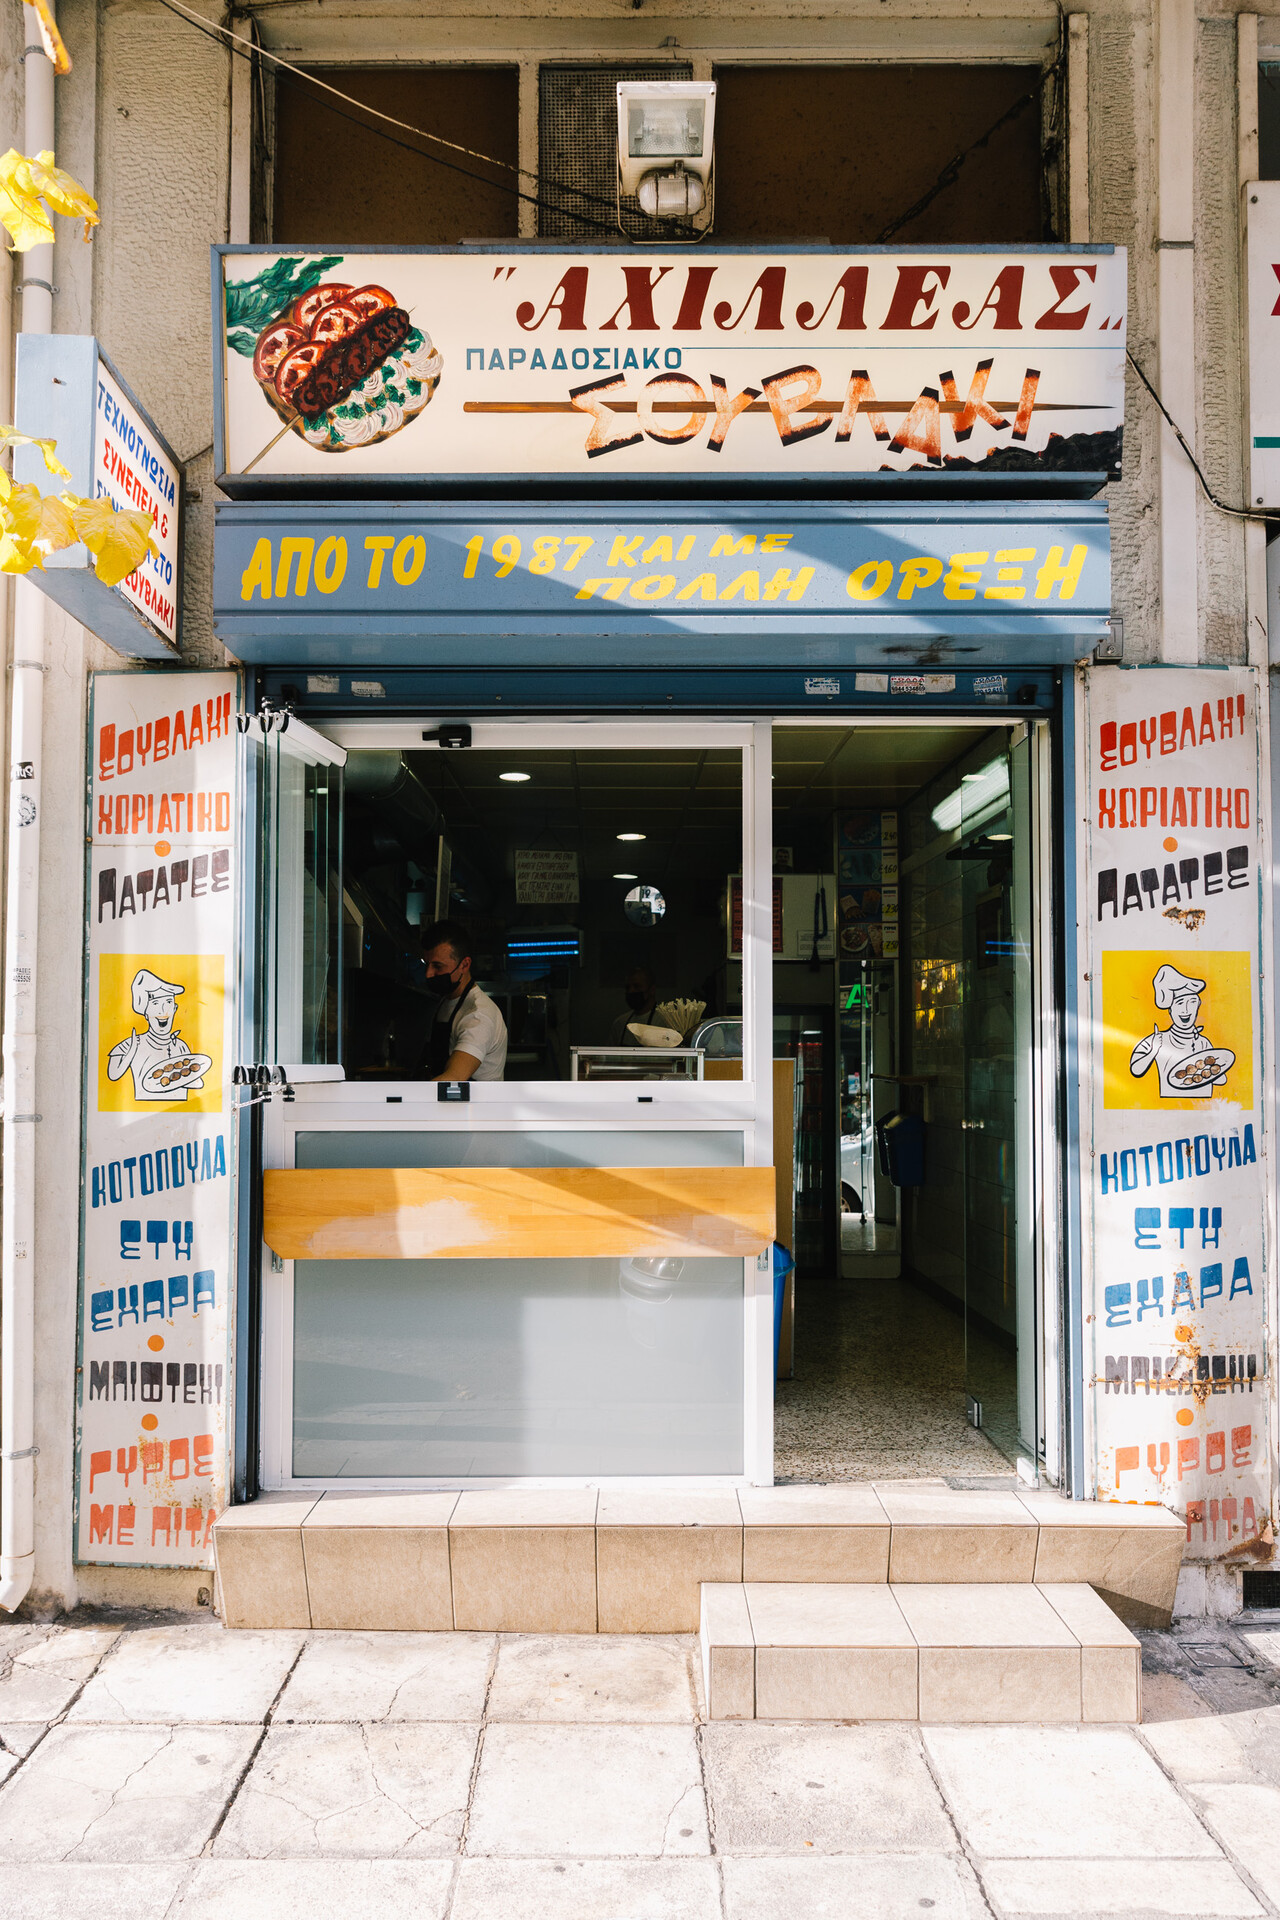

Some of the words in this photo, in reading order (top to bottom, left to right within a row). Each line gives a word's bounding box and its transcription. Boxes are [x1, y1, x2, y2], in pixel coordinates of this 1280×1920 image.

[466, 347, 682, 371] ΠΑΡΑΔΟΣΙΑΚΟ
[98, 380, 176, 508] ΤΕΧΝΟΓΝΩΣΙΑ
[569, 358, 1041, 467] ΣΟΥΒΛΑΚΙ
[103, 437, 159, 530] ΣΥΝΕΠΕΙΑ
[161, 513, 168, 539] &
[240, 535, 348, 601] ΑΠΟ
[364, 535, 426, 589] ΤΟ
[463, 535, 595, 579] 1987
[606, 534, 697, 568] ΚΑΙ
[708, 533, 794, 558] ΜΕ
[574, 566, 816, 601] ΠΟΛΛΗ
[846, 544, 1088, 600] ΟΡΕΞΗ
[98, 692, 231, 782] ΣΟΥΒΛΑΚΙ
[1100, 693, 1245, 771] ΣΟΥΒΛΑΚΙ
[98, 792, 230, 835] ΧΩΡΙΑΤΙΚΟ
[1098, 787, 1250, 829] ΧΩΡΙΑΤΙΚΟ
[98, 849, 230, 924] ΠΑΤΑΤΕΣ
[1098, 845, 1250, 922] ΠΑΤΑΤΕΣ
[92, 1134, 226, 1208] ΚΟΤΟΠΟΥΛΑ
[1100, 1123, 1257, 1195] ΚΟΤΟΠΟΥΛΑ
[120, 1220, 193, 1260] ΣΤΗ
[1134, 1207, 1222, 1249] ΣΤΗ
[91, 1269, 215, 1332] ΣΧΑΡΑ
[1105, 1256, 1253, 1328] ΣΧΑΡΑ
[89, 1360, 223, 1404] ΜΠΙΦΤΕΚΙ
[89, 1434, 214, 1494] ΓΥΡΟΣ
[1115, 1425, 1252, 1489] ΓΥΡΟΣ
[89, 1503, 136, 1546] ΜΕ
[1186, 1496, 1259, 1543] ΠΙΤΑ
